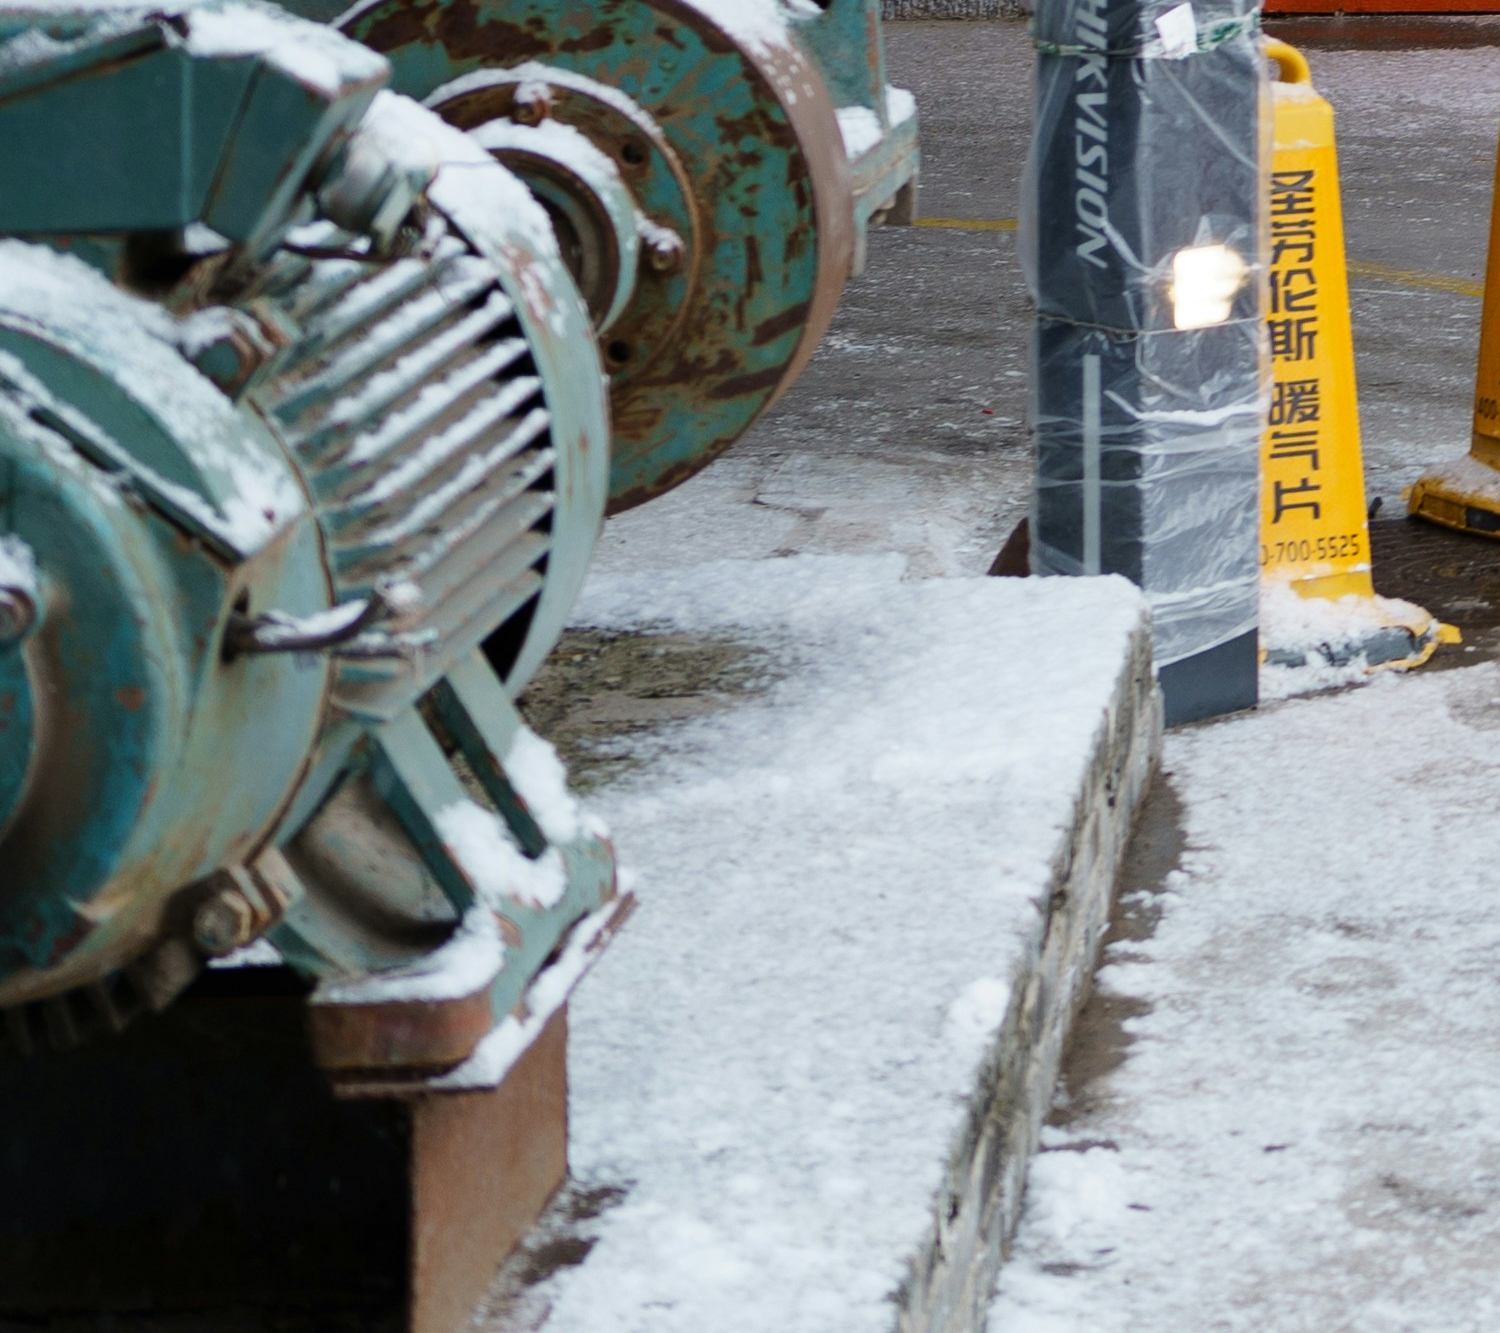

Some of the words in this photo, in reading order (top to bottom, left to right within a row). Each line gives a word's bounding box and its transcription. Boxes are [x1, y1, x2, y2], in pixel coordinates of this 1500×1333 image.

[1268, 169, 1319, 362] 圣劳伦斯
[1268, 377, 1322, 524] 暖气片
